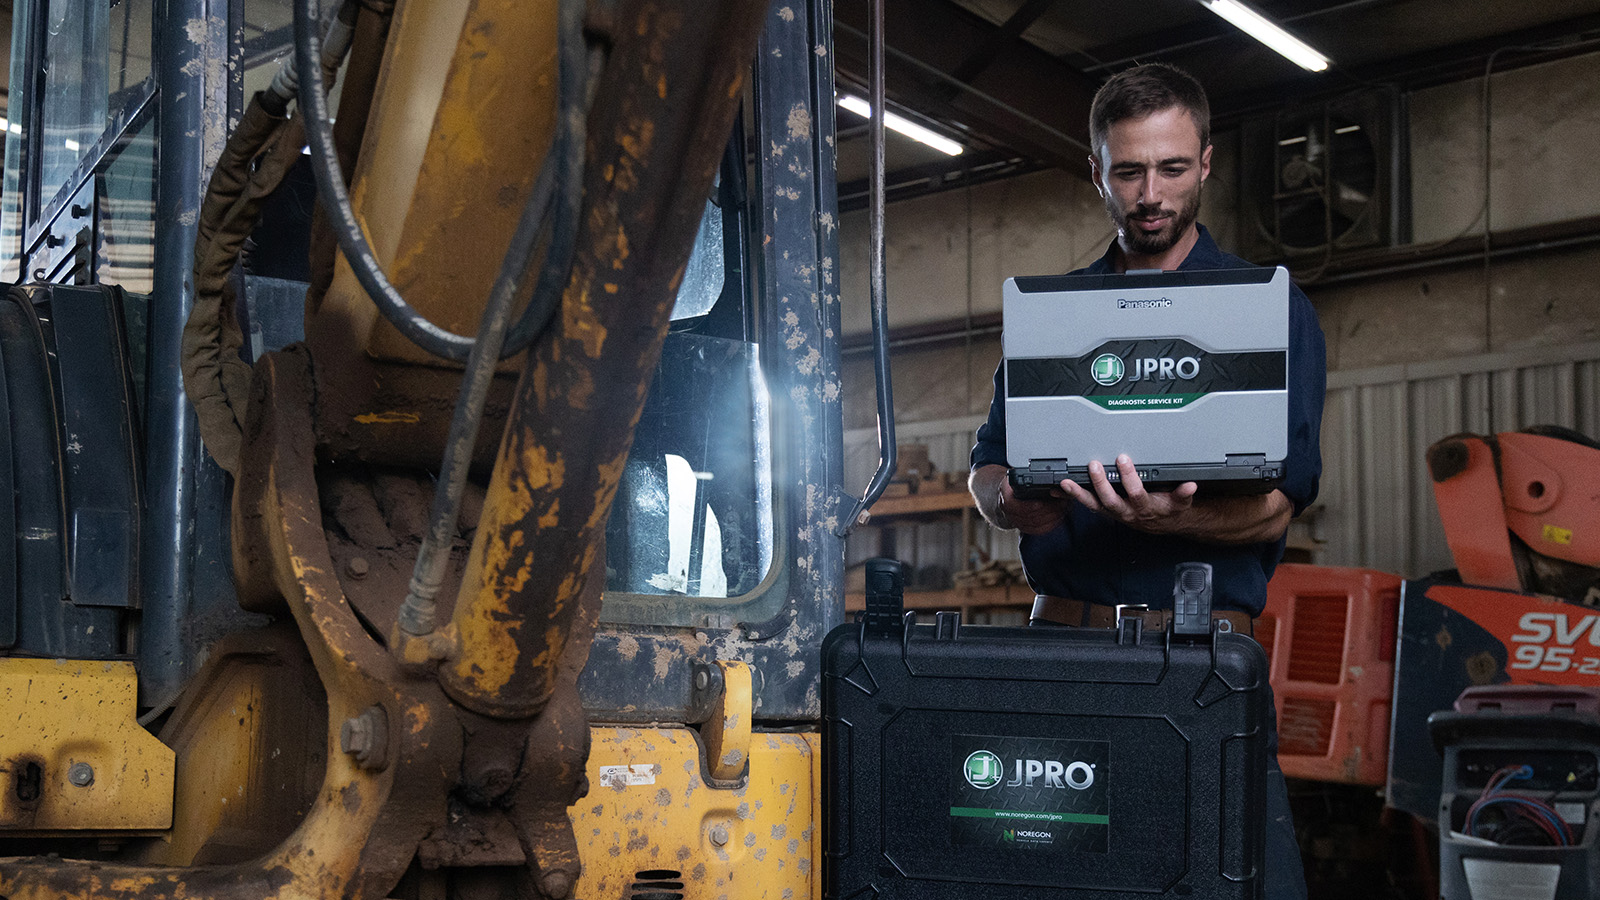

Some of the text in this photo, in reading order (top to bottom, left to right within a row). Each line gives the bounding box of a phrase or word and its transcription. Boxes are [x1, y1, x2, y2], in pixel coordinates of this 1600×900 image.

[1117, 297, 1172, 309] Panasonic
[1128, 356, 1200, 382] JPRO
[1511, 645, 1600, 675] 95-2
[1006, 759, 1095, 791] JPRO
[994, 811, 1063, 821] www.noregon.com/jpro
[1017, 830, 1052, 838] NOREGON
